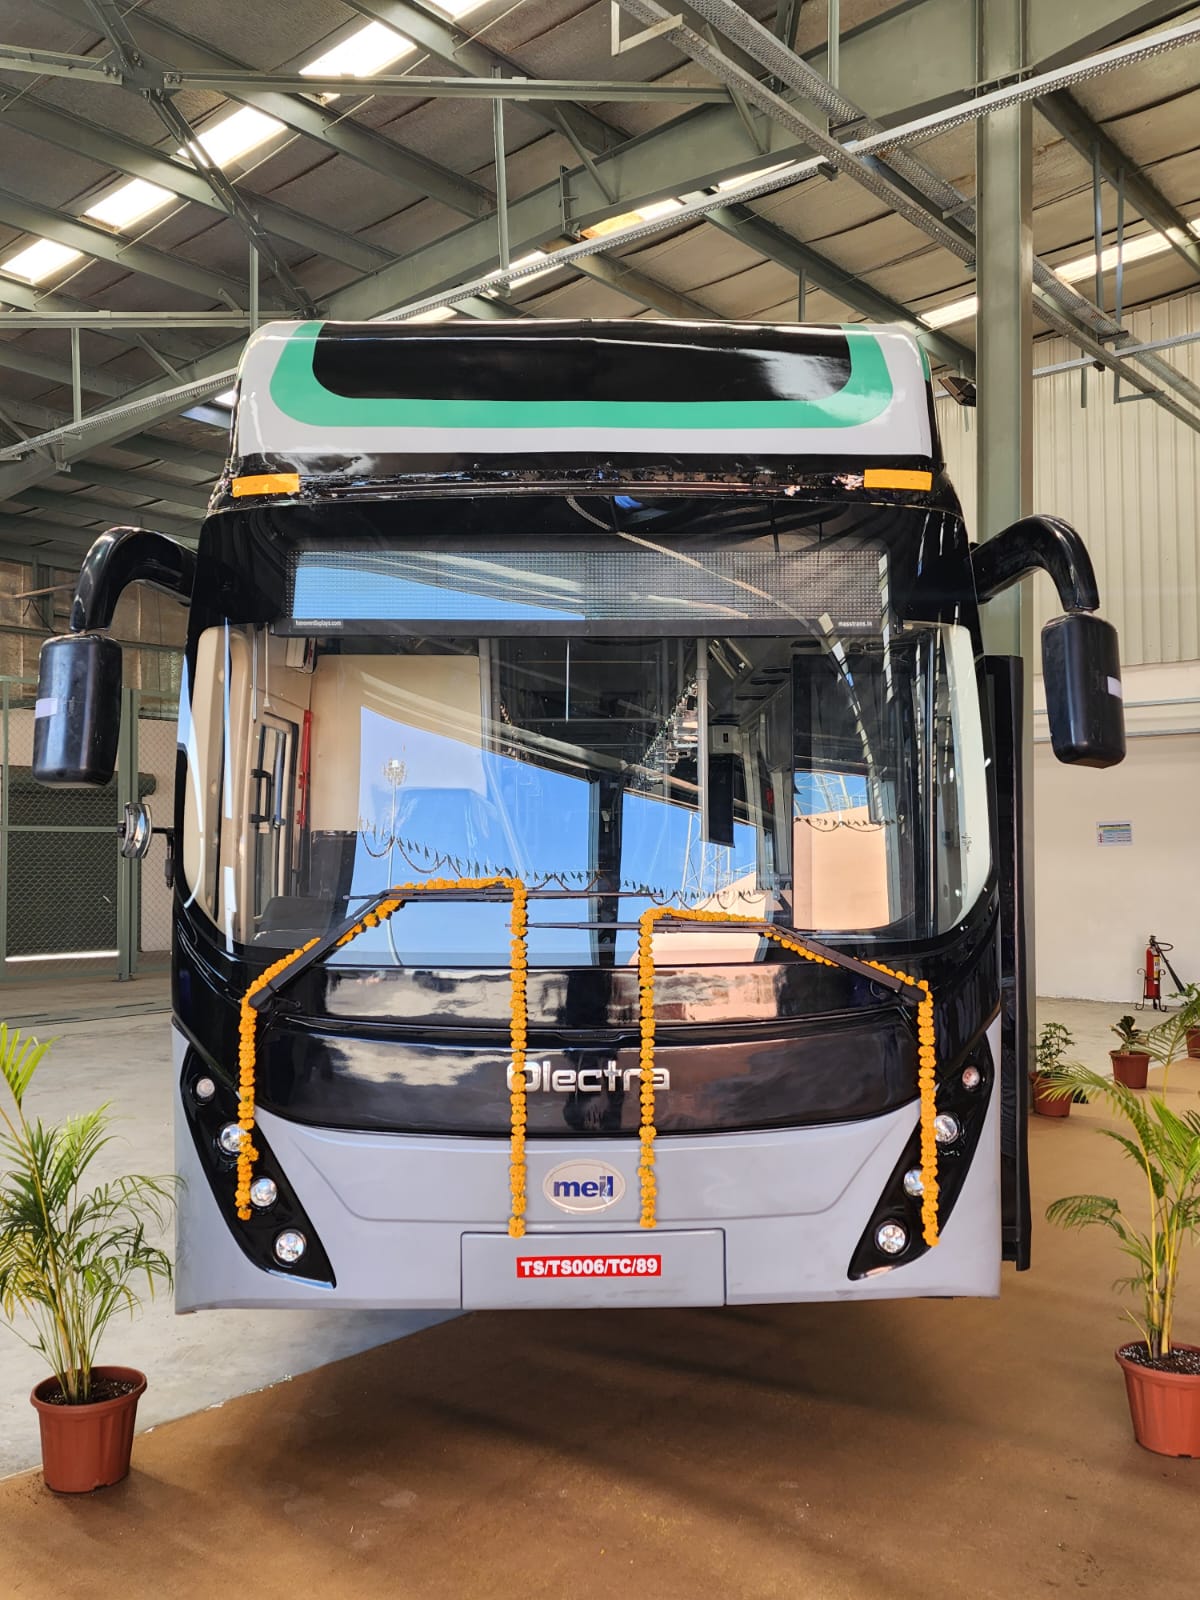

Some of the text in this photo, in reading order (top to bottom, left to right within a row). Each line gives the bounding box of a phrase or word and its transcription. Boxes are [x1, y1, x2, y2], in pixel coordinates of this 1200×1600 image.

[506, 1060, 671, 1092] Olectra
[553, 1175, 614, 1197] meil
[521, 1258, 658, 1276] TS/TS006/TC/89
